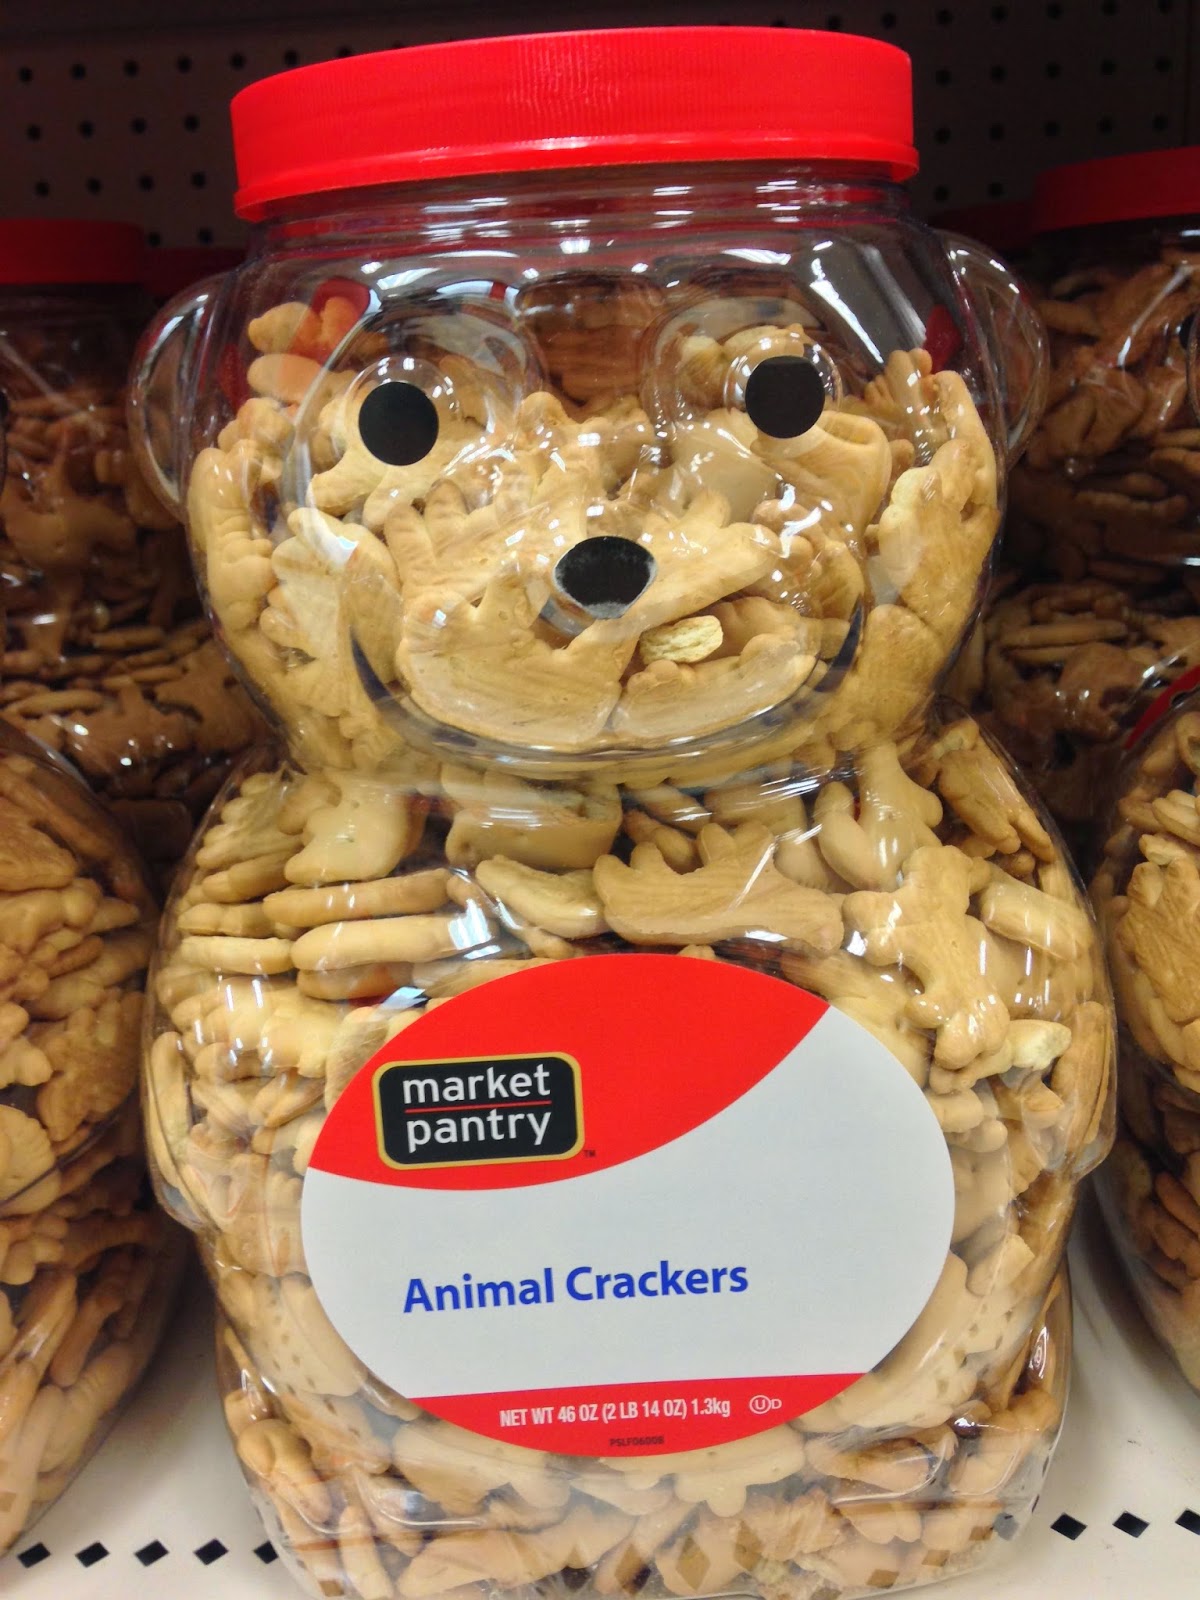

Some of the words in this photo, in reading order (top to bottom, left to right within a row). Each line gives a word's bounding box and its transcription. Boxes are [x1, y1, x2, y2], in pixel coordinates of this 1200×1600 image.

[402, 1063, 551, 1104] market
[406, 1109, 552, 1154] pantry
[403, 1267, 555, 1313] Animal
[566, 1260, 749, 1301] Crackers
[499, 1409, 528, 1427] NET
[531, 1407, 554, 1426] WT
[557, 1405, 576, 1424] 46
[578, 1404, 599, 1422] OZ
[602, 1404, 617, 1424] (2
[619, 1402, 639, 1420] LB
[642, 1401, 661, 1418] 14
[663, 1398, 688, 1420] OZ)
[690, 1397, 731, 1417] 1.3kg
